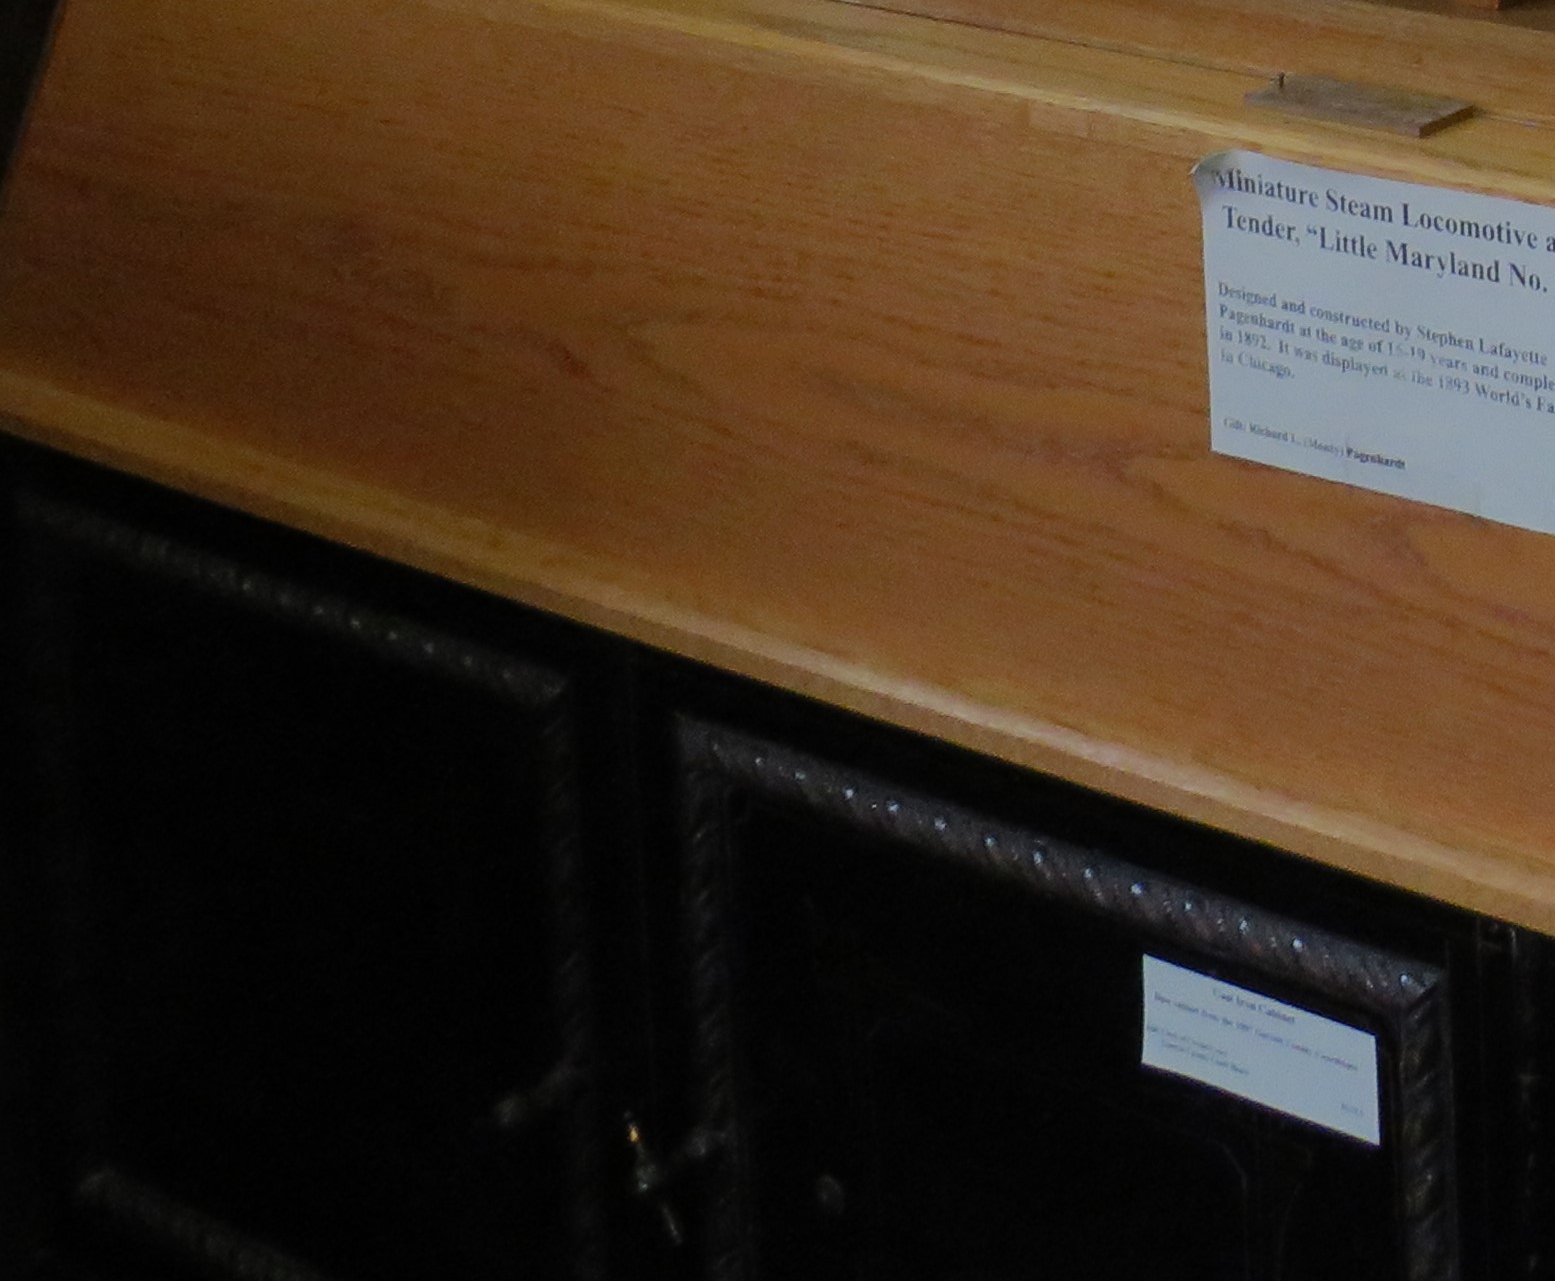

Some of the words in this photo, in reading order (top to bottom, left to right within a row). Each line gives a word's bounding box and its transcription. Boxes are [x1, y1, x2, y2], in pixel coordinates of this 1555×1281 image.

[1213, 168, 1319, 207] Miniature
[1326, 188, 1393, 222] Steam
[1400, 202, 1538, 250] Locomotive
[1222, 205, 1300, 247] Tender,
[1306, 225, 1377, 260] “Little
[1386, 239, 1500, 283] Maryland
[1508, 262, 1548, 293] No.
[1218, 282, 1277, 307] Designed
[1281, 298, 1306, 315] and
[1310, 306, 1390, 333] constructed
[1395, 321, 1412, 340] by
[1416, 324, 1474, 350] Stephen
[1479, 338, 1548, 366] Lafayette
[1219, 303, 1295, 334] Pagenhardt
[1300, 325, 1312, 337] at
[1316, 327, 1337, 344] the
[1341, 337, 1363, 352] age
[1368, 340, 1384, 354] of
[1430, 353, 1468, 372] years
[1472, 363, 1499, 379] and
[1219, 325, 1233, 341] in
[1278, 340, 1289, 354] It
[1294, 347, 1318, 362] was
[1322, 350, 1388, 378] displayed
[1475, 383, 1532, 410] World’s
